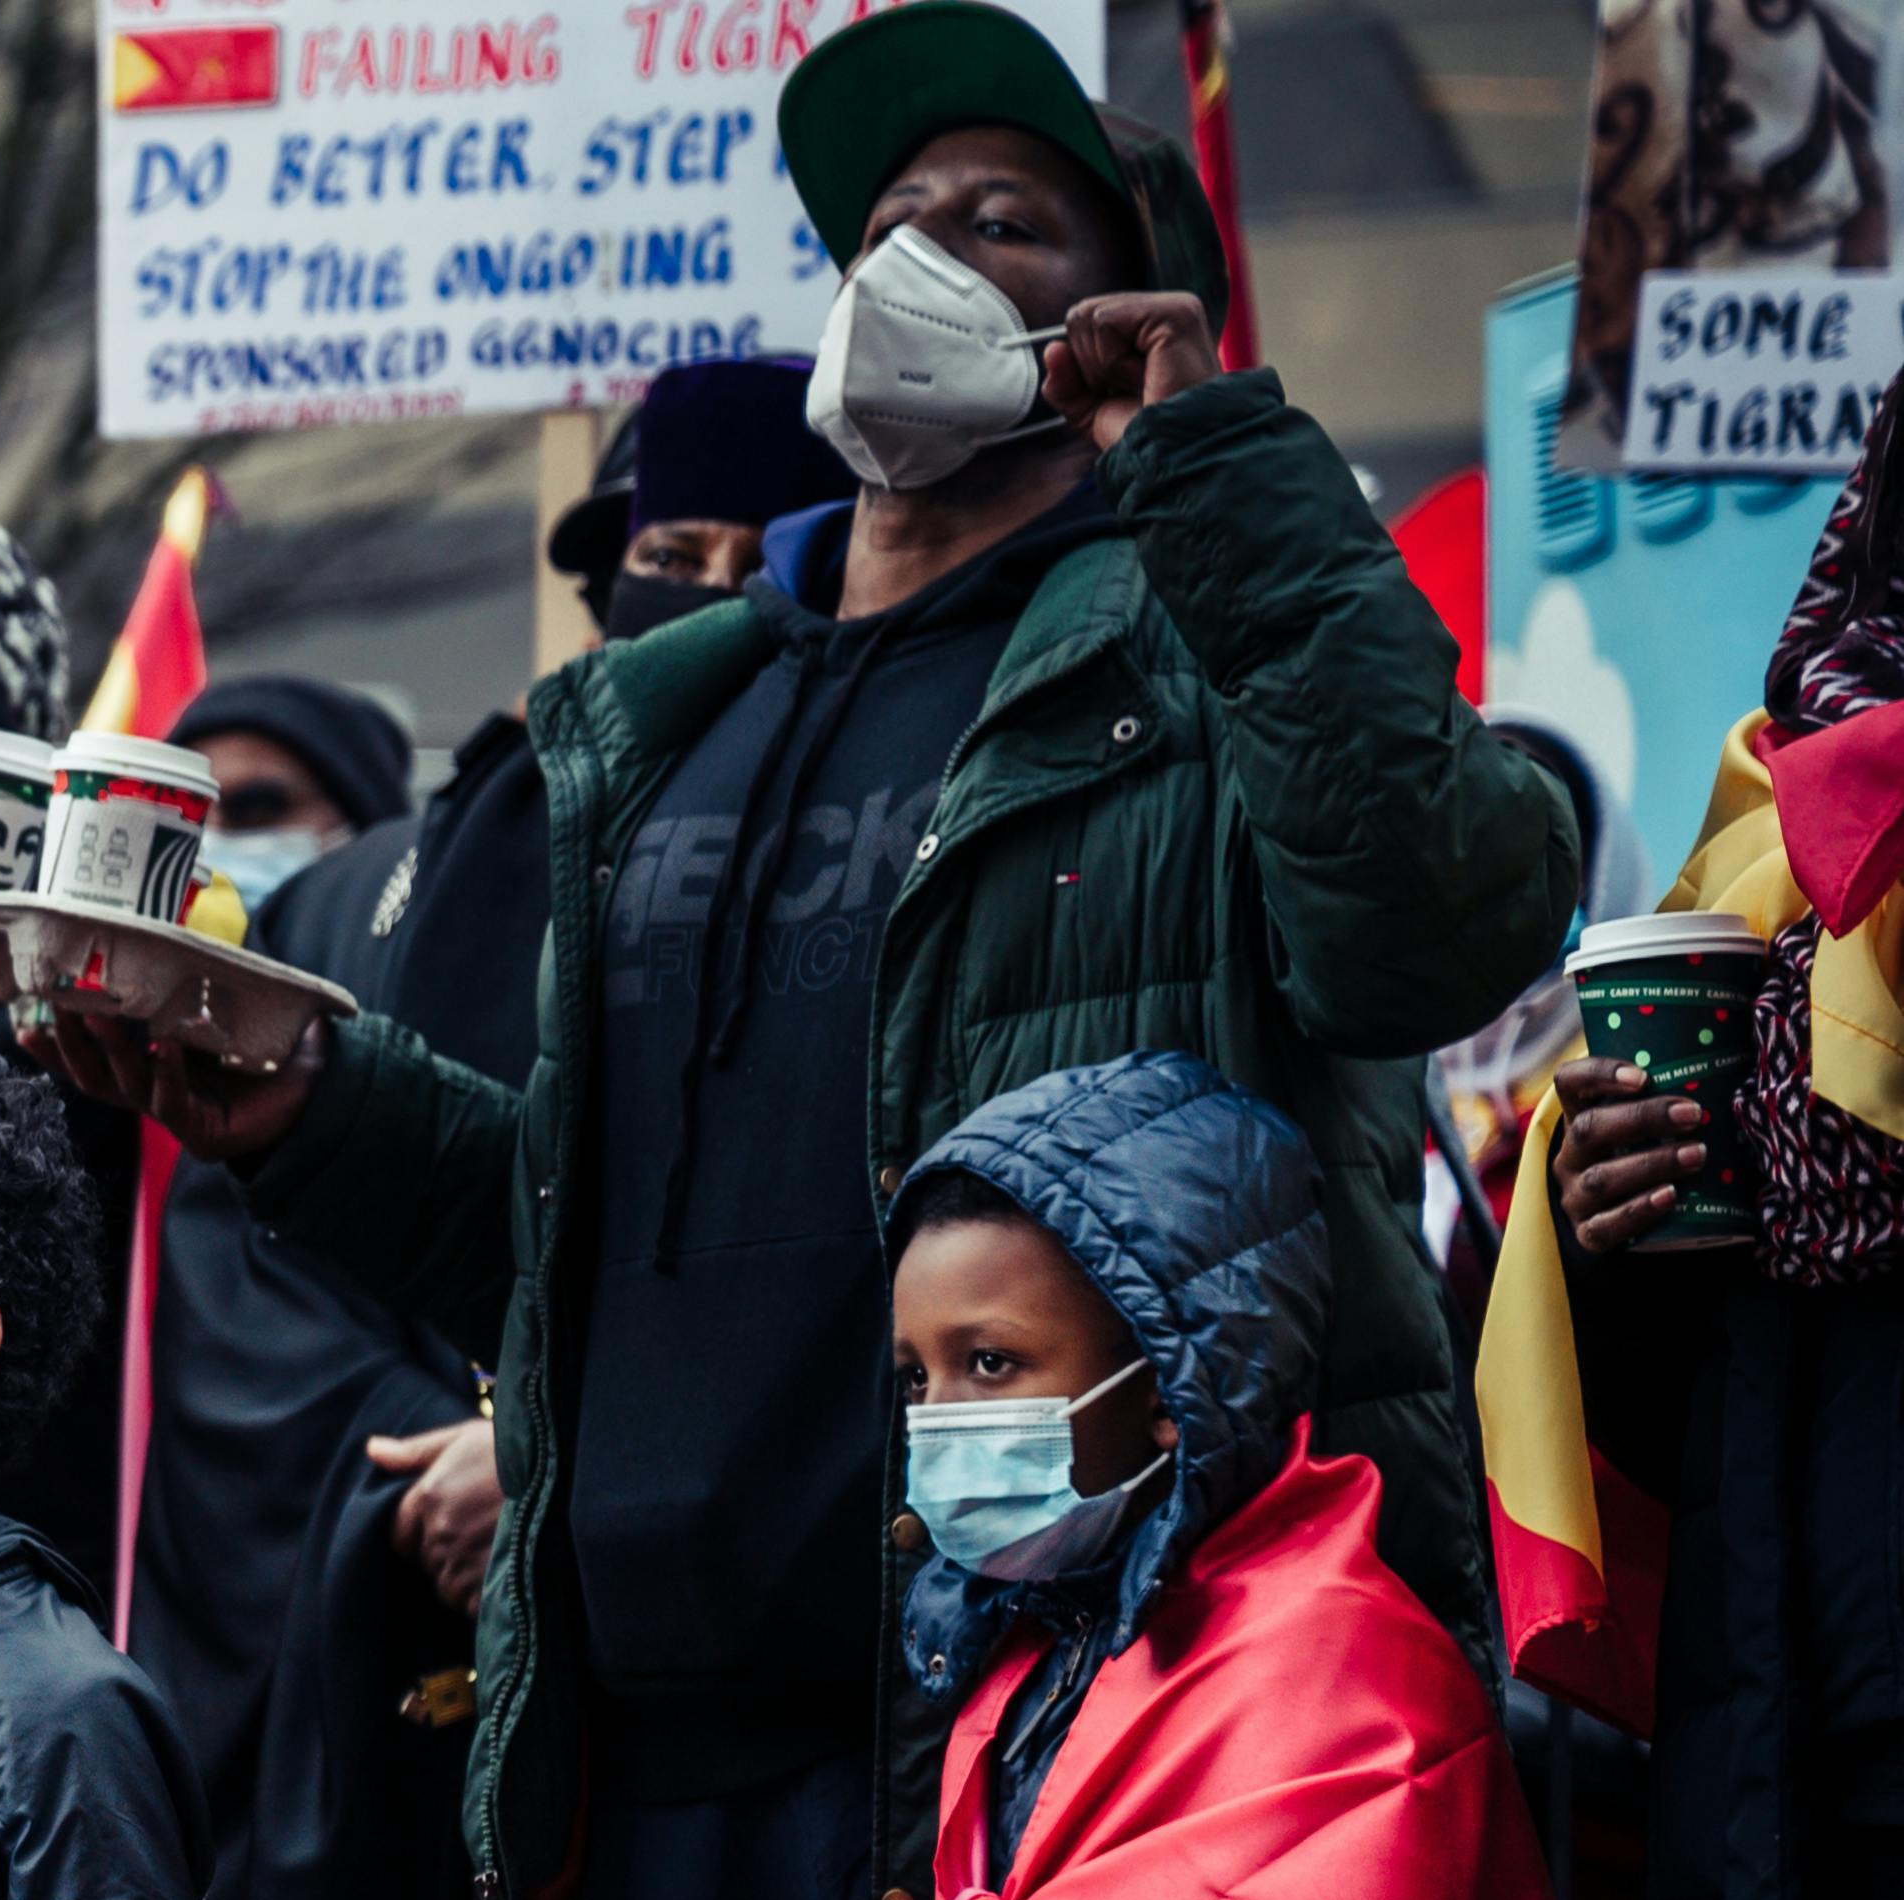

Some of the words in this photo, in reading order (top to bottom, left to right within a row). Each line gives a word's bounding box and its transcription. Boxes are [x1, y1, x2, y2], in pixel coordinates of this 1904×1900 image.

[299, 14, 559, 96] FAILING
[623, 0, 905, 79] TIGR
[128, 137, 230, 216] DO
[576, 108, 753, 195] STEP
[135, 235, 291, 318] STOP
[299, 241, 406, 313] THE
[436, 216, 733, 300] ONGOING
[146, 325, 450, 404] SPONSORED
[1658, 289, 1853, 363] SOME
[1609, 987, 1641, 999] CARRY
[1642, 986, 1662, 998] THE
[1663, 986, 1701, 998] MERRY
[1652, 1069, 1673, 1084] THE
[1673, 1061, 1709, 1079] MERRY
